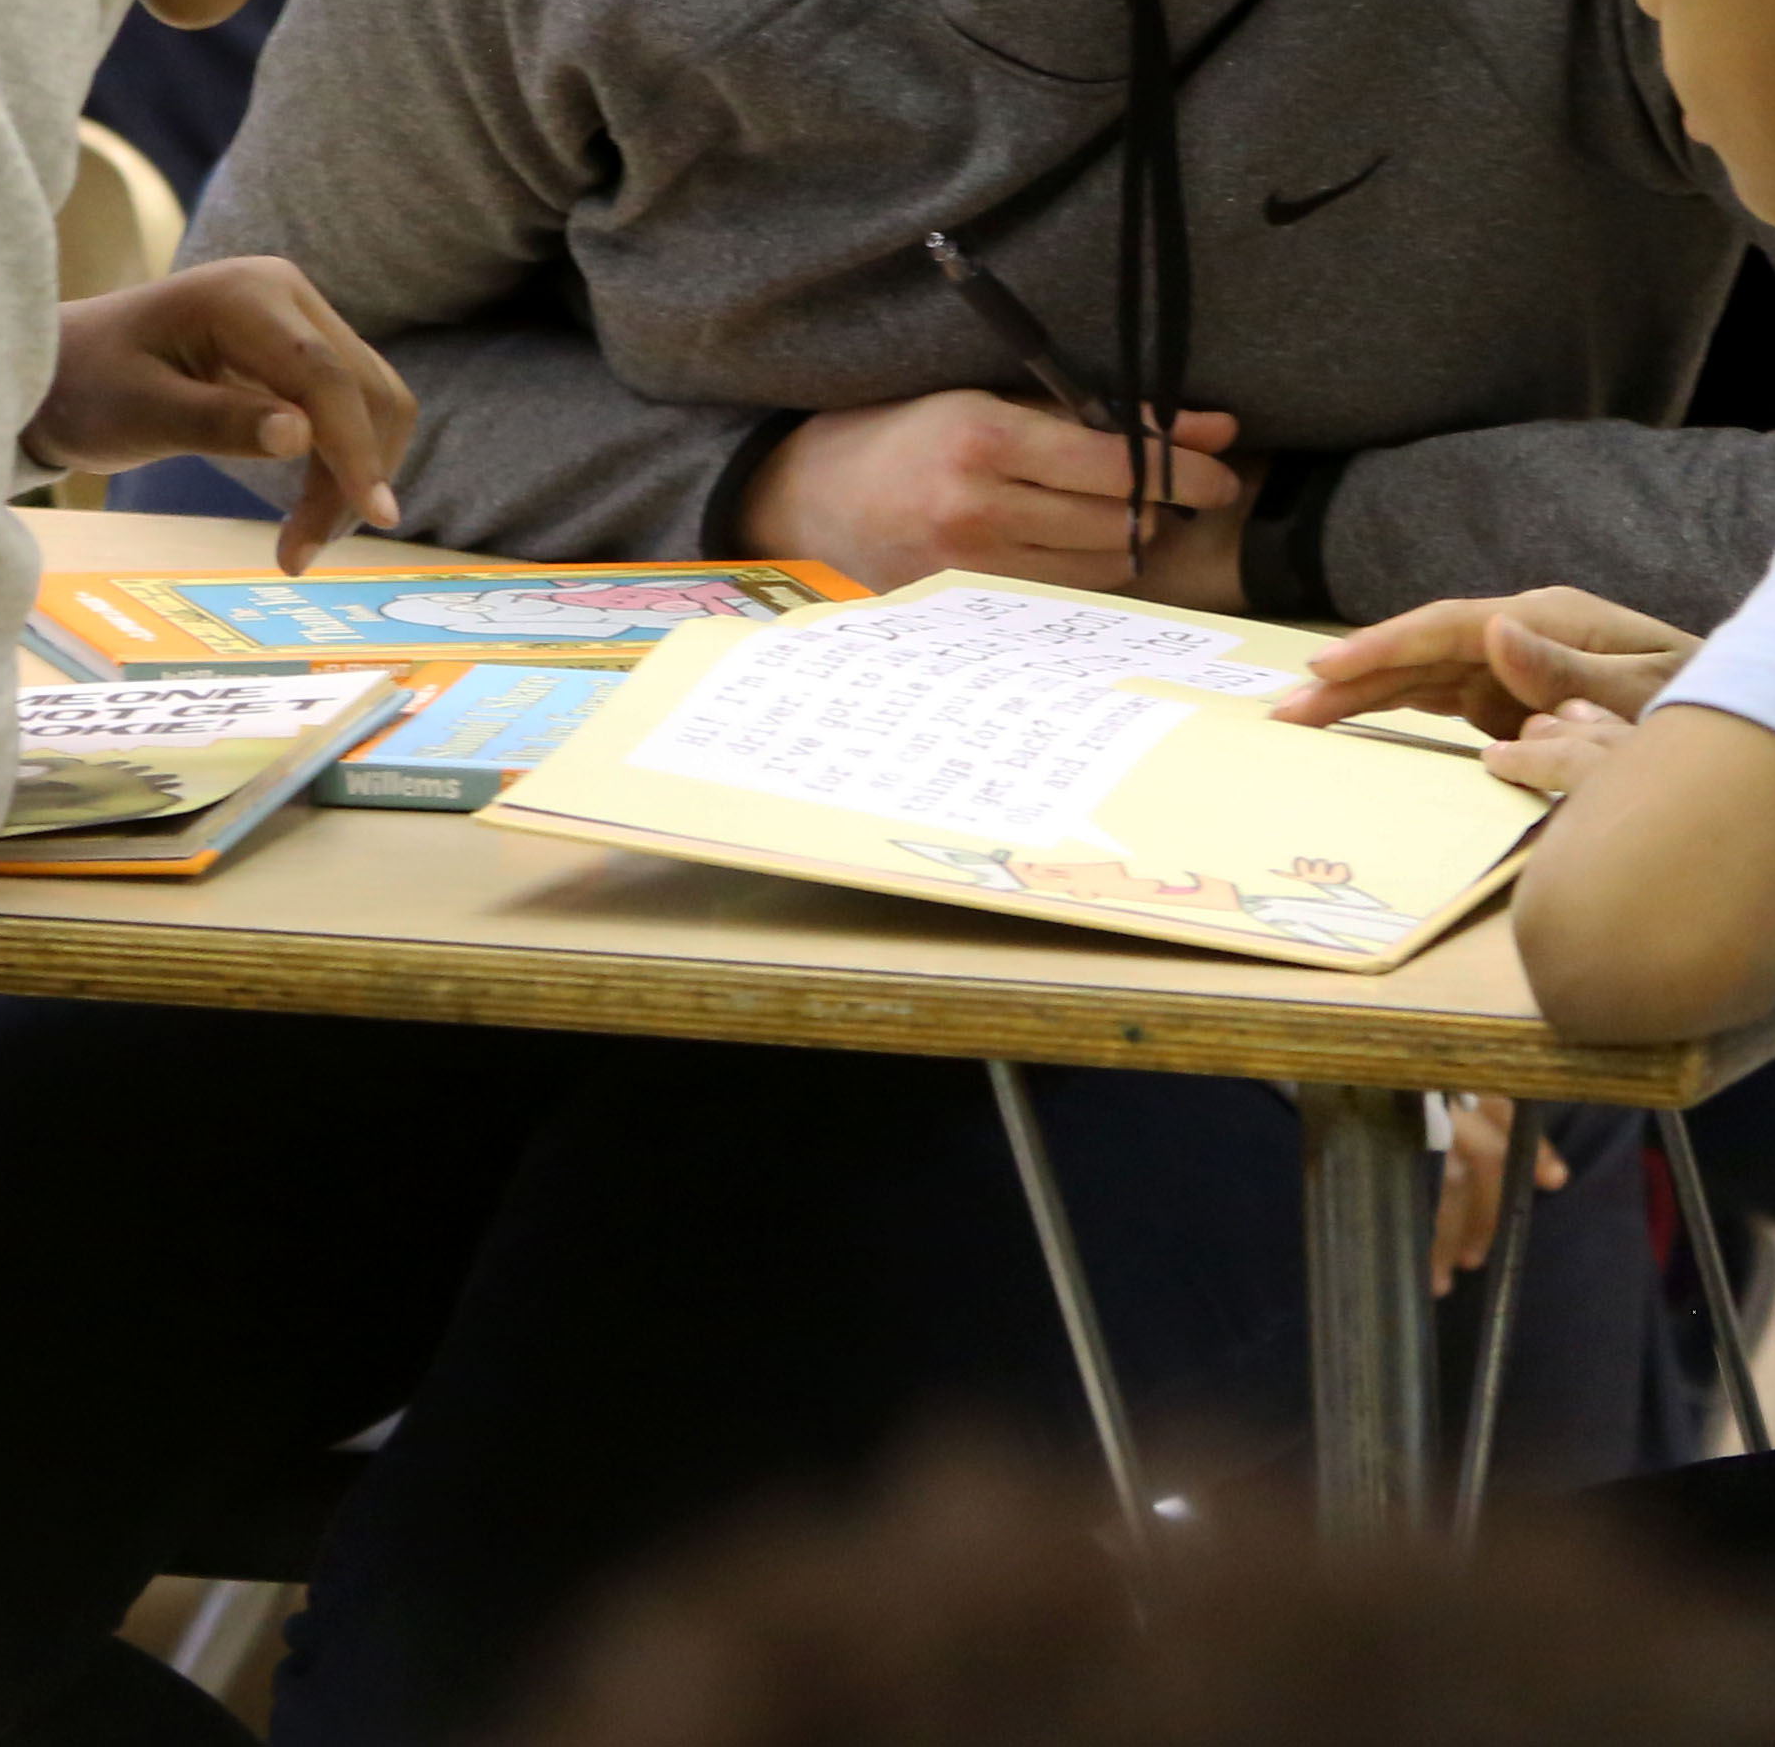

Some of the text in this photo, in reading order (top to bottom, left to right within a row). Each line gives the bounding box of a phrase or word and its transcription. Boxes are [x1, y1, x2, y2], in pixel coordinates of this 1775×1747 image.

[169, 698, 340, 717] GET
[816, 697, 861, 730] got
[850, 671, 883, 689] to
[18, 719, 237, 737] OKIE!
[343, 769, 463, 800] Willems
[900, 757, 975, 811] things
[1044, 756, 1088, 790] and
